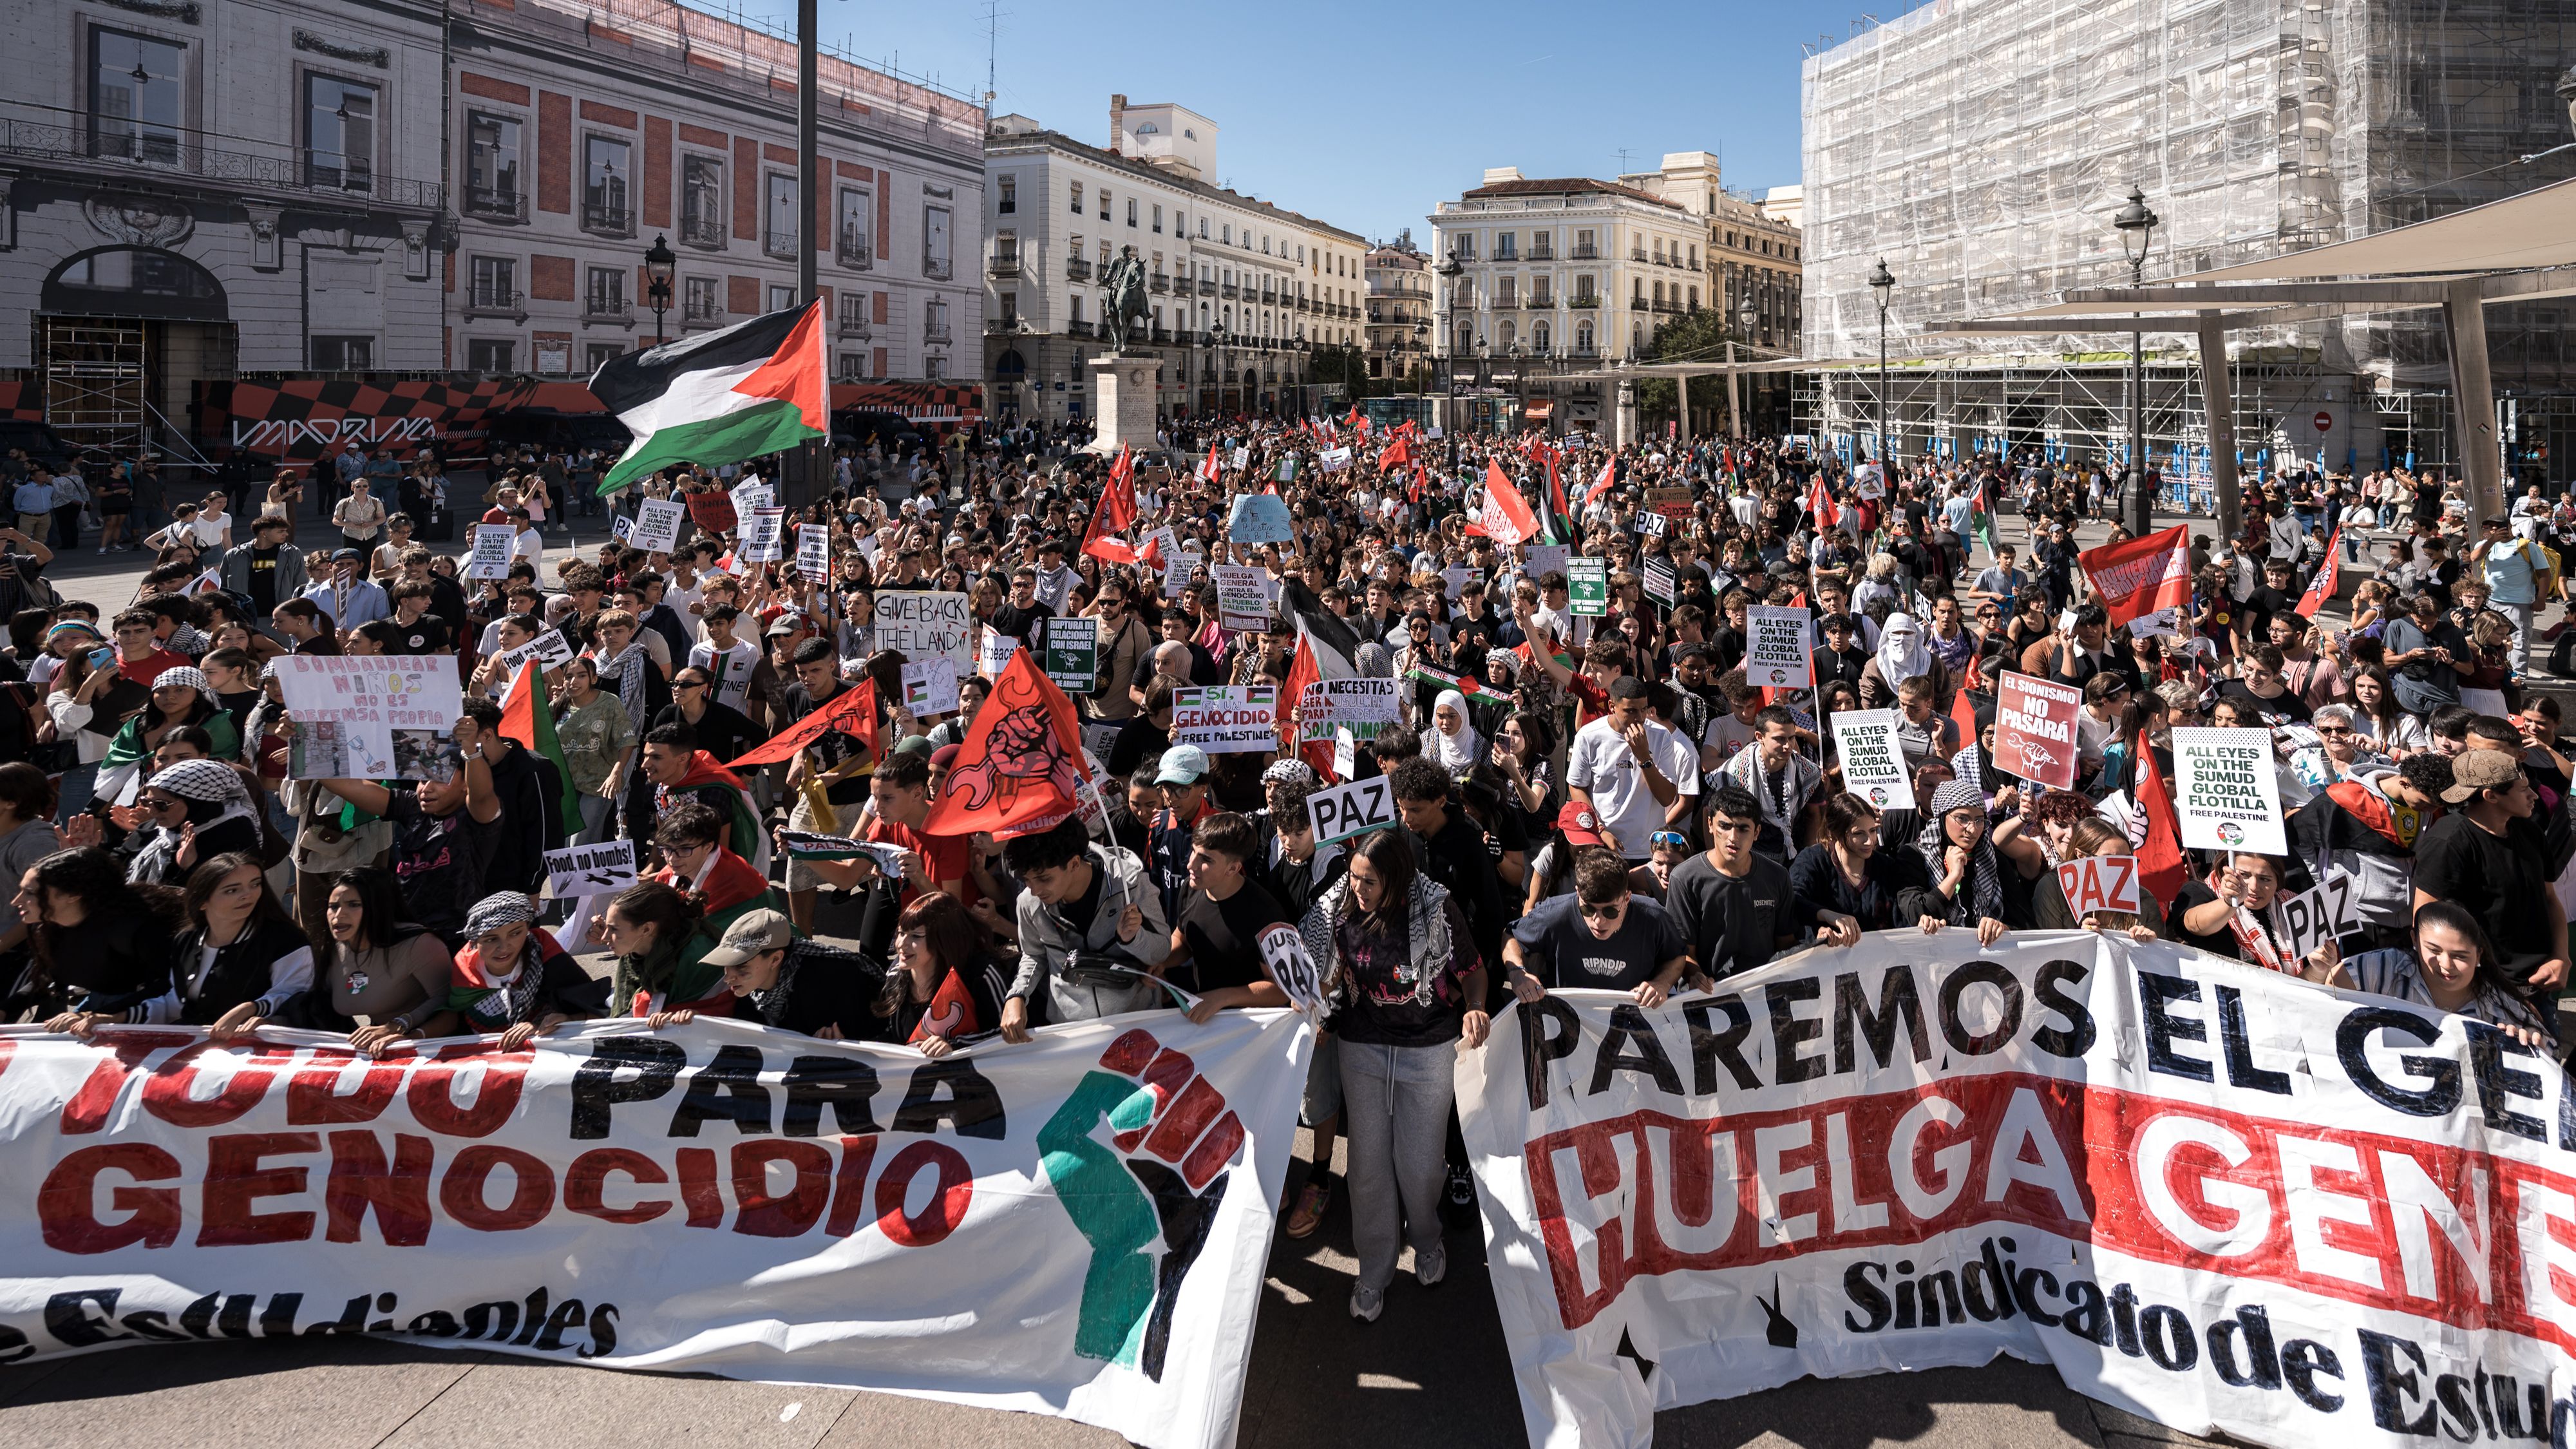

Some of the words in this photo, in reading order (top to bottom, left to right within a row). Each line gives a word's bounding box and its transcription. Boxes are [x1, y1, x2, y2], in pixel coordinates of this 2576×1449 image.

[926, 404, 956, 417] MADRID
[643, 522, 672, 531] GLOBAL
[645, 517, 672, 526] SUMUD
[1635, 511, 1665, 536] PAZ
[639, 527, 672, 536] FLOTILLA
[2093, 553, 2169, 588] IZQUIERDA
[875, 595, 916, 621] GIVE
[919, 596, 965, 622] BACK
[1915, 591, 1931, 623] PAZ
[1050, 620, 1084, 630] RUPTURA
[1084, 621, 1095, 630] DE
[1755, 618, 1774, 627] ALL
[1776, 620, 1803, 629] EYES
[1050, 630, 1094, 640] RELACIONES
[1759, 628, 1777, 636] ON
[1777, 628, 1798, 636] THE
[875, 628, 911, 650] THE
[914, 630, 958, 652] LAND
[1050, 639, 1065, 649] CON
[1066, 641, 1092, 650] ISRAEL
[1759, 636, 1798, 645] SUMUD
[1757, 644, 1800, 653] GLOBAL
[1754, 652, 1803, 662] FLOTILLA
[292, 656, 439, 674] BOMBARDEAR
[332, 671, 422, 694] NIÑOS
[1304, 683, 1324, 697] NO
[1329, 681, 1394, 696] NECESITAS
[2004, 676, 2016, 690] EL
[2017, 679, 2076, 705] SIONISMO
[354, 694, 379, 707] NO
[387, 694, 408, 707] ES
[1201, 700, 1220, 710] ES
[1224, 701, 1242, 711] UN
[1303, 696, 1321, 708] SER
[1324, 695, 1383, 708] MUSULMAN
[2023, 695, 2049, 718] NO
[292, 707, 380, 723] DEFENSA
[388, 710, 444, 725] PROPIA
[1175, 710, 1271, 728] GENOCIDIO
[1302, 709, 1325, 719] PARA
[1327, 708, 1376, 720] DEFENDER
[1303, 721, 1334, 739] SOLO
[1841, 727, 1859, 736] ALL
[1860, 725, 1888, 735] EYES
[2000, 707, 2069, 743] PASARÁ
[1182, 733, 1210, 743] FREE
[1847, 737, 1863, 746] ON
[1864, 736, 1886, 745] THE
[1849, 746, 1888, 757] SUMUD
[2186, 746, 2214, 757] ALL
[2217, 747, 2260, 759] EYES
[1849, 756, 1893, 766] GLOBAL
[2193, 759, 2217, 770] ON
[2220, 759, 2254, 772] THE
[1848, 766, 1899, 777] FLOTILLA
[2193, 771, 2255, 784] SUMUD
[2192, 783, 2261, 797] GLOBAL
[2188, 795, 2268, 811] FLOTILLA
[1314, 783, 1390, 840] PAZ
[2214, 811, 2269, 822] PALESTINE
[545, 853, 578, 873] Food,
[576, 853, 592, 871] no
[591, 844, 632, 868] bombs!
[2059, 858, 2137, 922] PAZ
[1753, 900, 1776, 908] YOSEMITE!
[2286, 879, 2360, 959] PAZ
[1582, 957, 1627, 974] RIPNDIP
[1517, 960, 2097, 1112] PAREMOS
[2137, 970, 2293, 1095] EL
[61, 1030, 536, 1138] TODO
[569, 1036, 1007, 1141] PARA
[37, 1128, 973, 1255] GENOCIDIO
[1549, 1088, 2092, 1301] HUELGA
[1844, 1235, 2198, 1372] Sindicato
[2206, 1303, 2345, 1414] de
